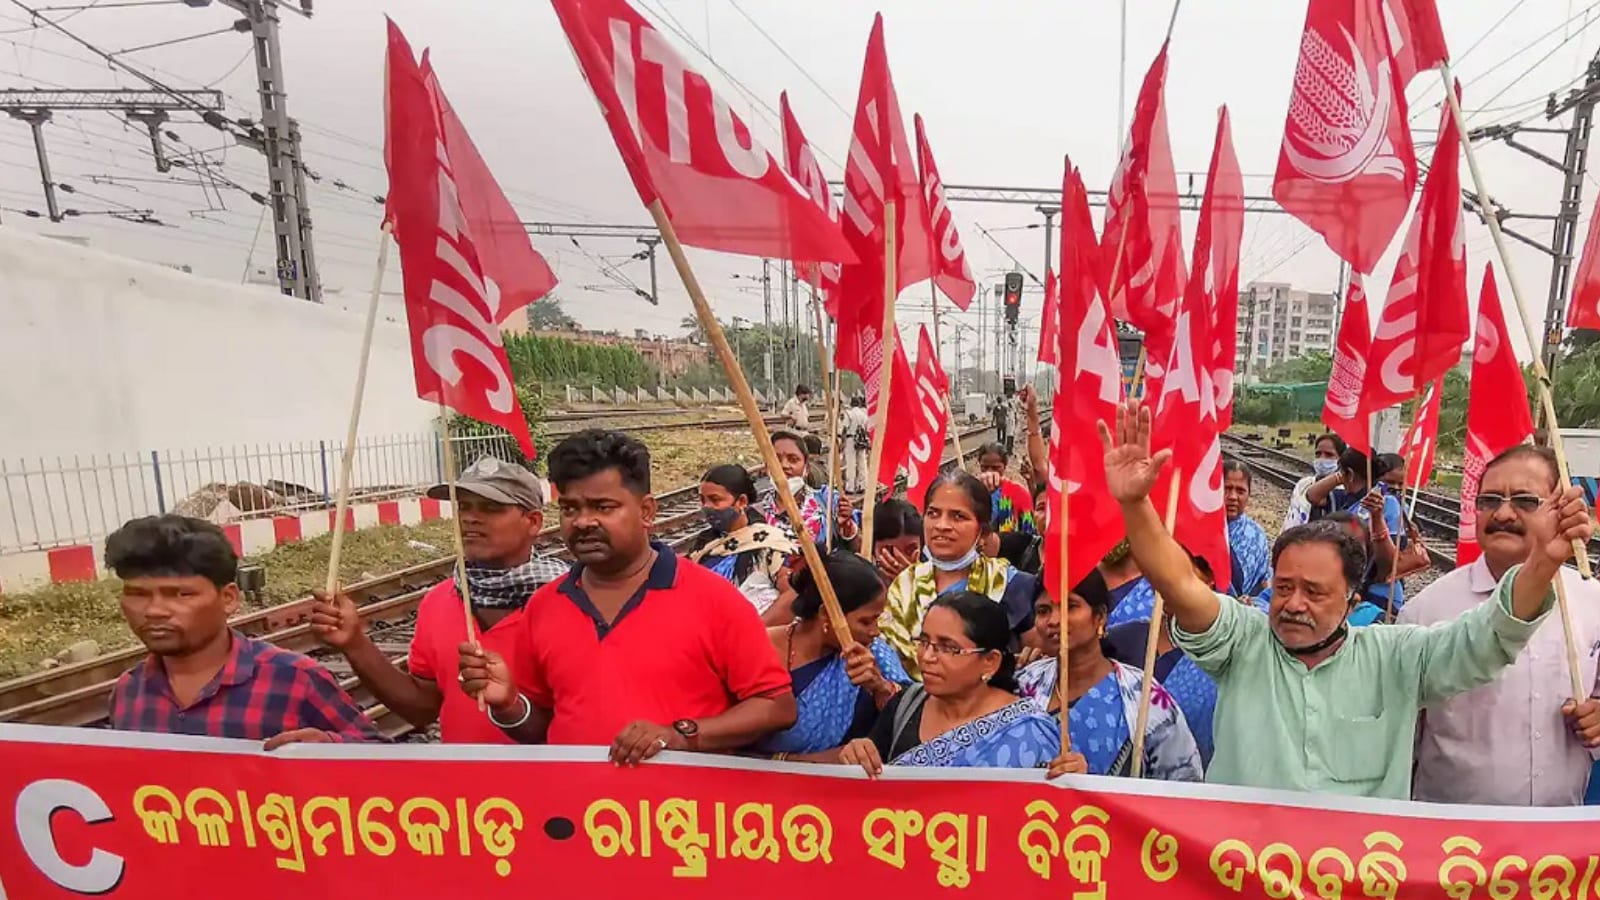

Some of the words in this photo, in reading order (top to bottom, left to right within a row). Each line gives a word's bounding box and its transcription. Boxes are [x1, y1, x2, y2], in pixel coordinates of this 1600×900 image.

[862, 808, 988, 888] ସଂସ୍ଥା
[1141, 828, 1179, 882] ଓ
[1438, 836, 1600, 900] ବିରୋ
